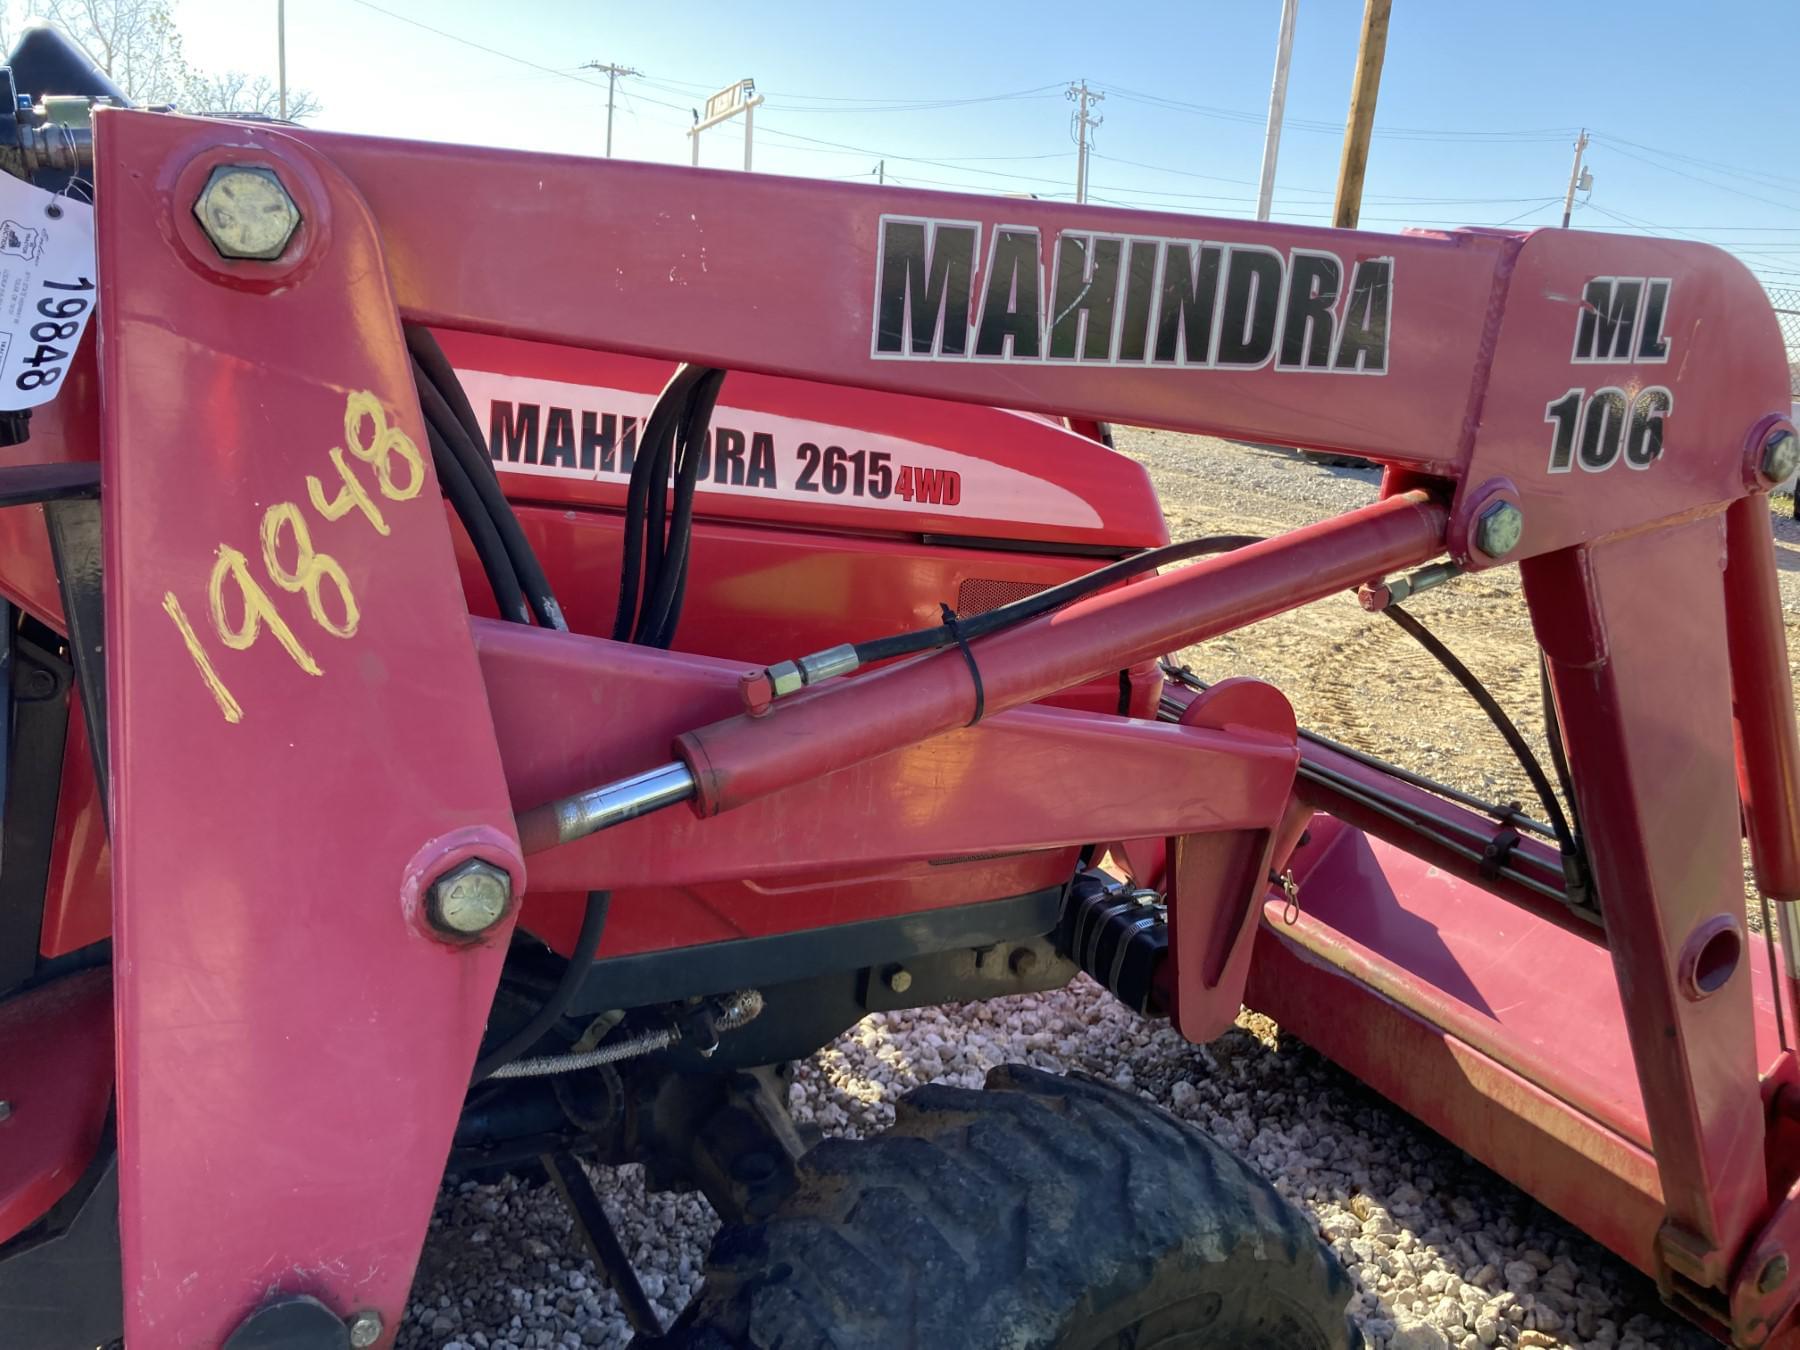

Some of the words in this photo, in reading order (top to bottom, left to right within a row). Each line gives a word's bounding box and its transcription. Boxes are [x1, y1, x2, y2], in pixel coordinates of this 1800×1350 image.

[16, 277, 95, 391] 19848
[870, 214, 1395, 376] MAHINDRA
[1570, 276, 1673, 365] ML
[489, 399, 778, 491] MAHIRA
[795, 442, 893, 500] 2615
[894, 465, 962, 507] 4WD
[1544, 385, 1674, 474] 106
[162, 389, 425, 724] 19848
